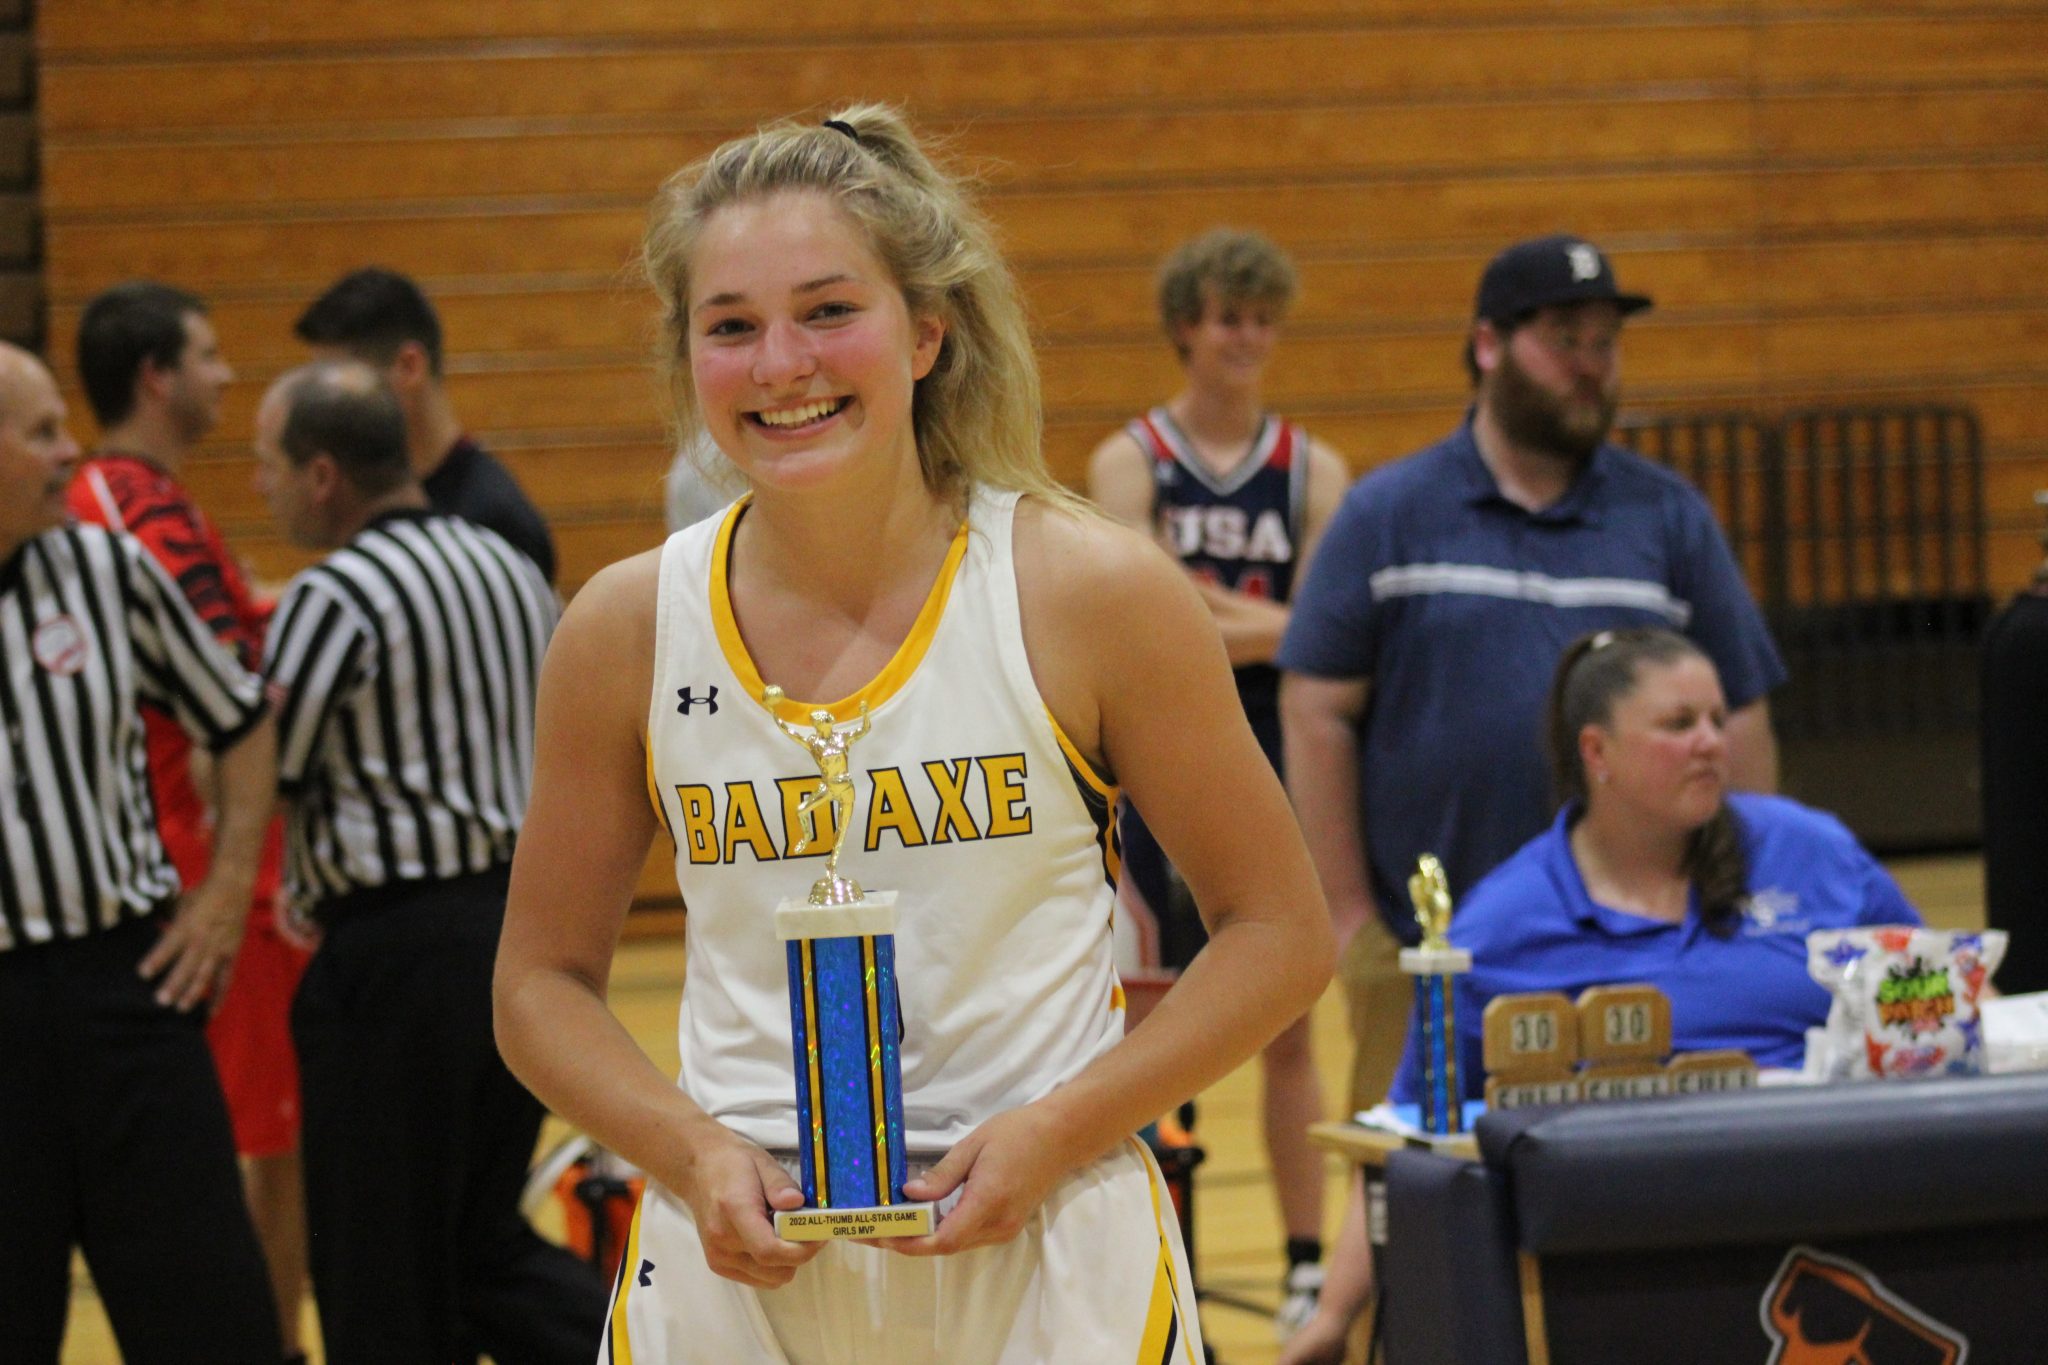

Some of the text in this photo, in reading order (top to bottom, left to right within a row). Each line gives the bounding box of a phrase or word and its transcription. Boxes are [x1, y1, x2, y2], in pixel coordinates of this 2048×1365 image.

[1165, 504, 1292, 563] USA
[675, 752, 1033, 865] BAD AXE
[1515, 1014, 1550, 1049] 30
[1613, 1004, 1645, 1041] 30
[789, 1212, 917, 1226] 2022 ALL-THUMB ALL-STAR GAME
[833, 1225, 876, 1236] GIRLS MVP
